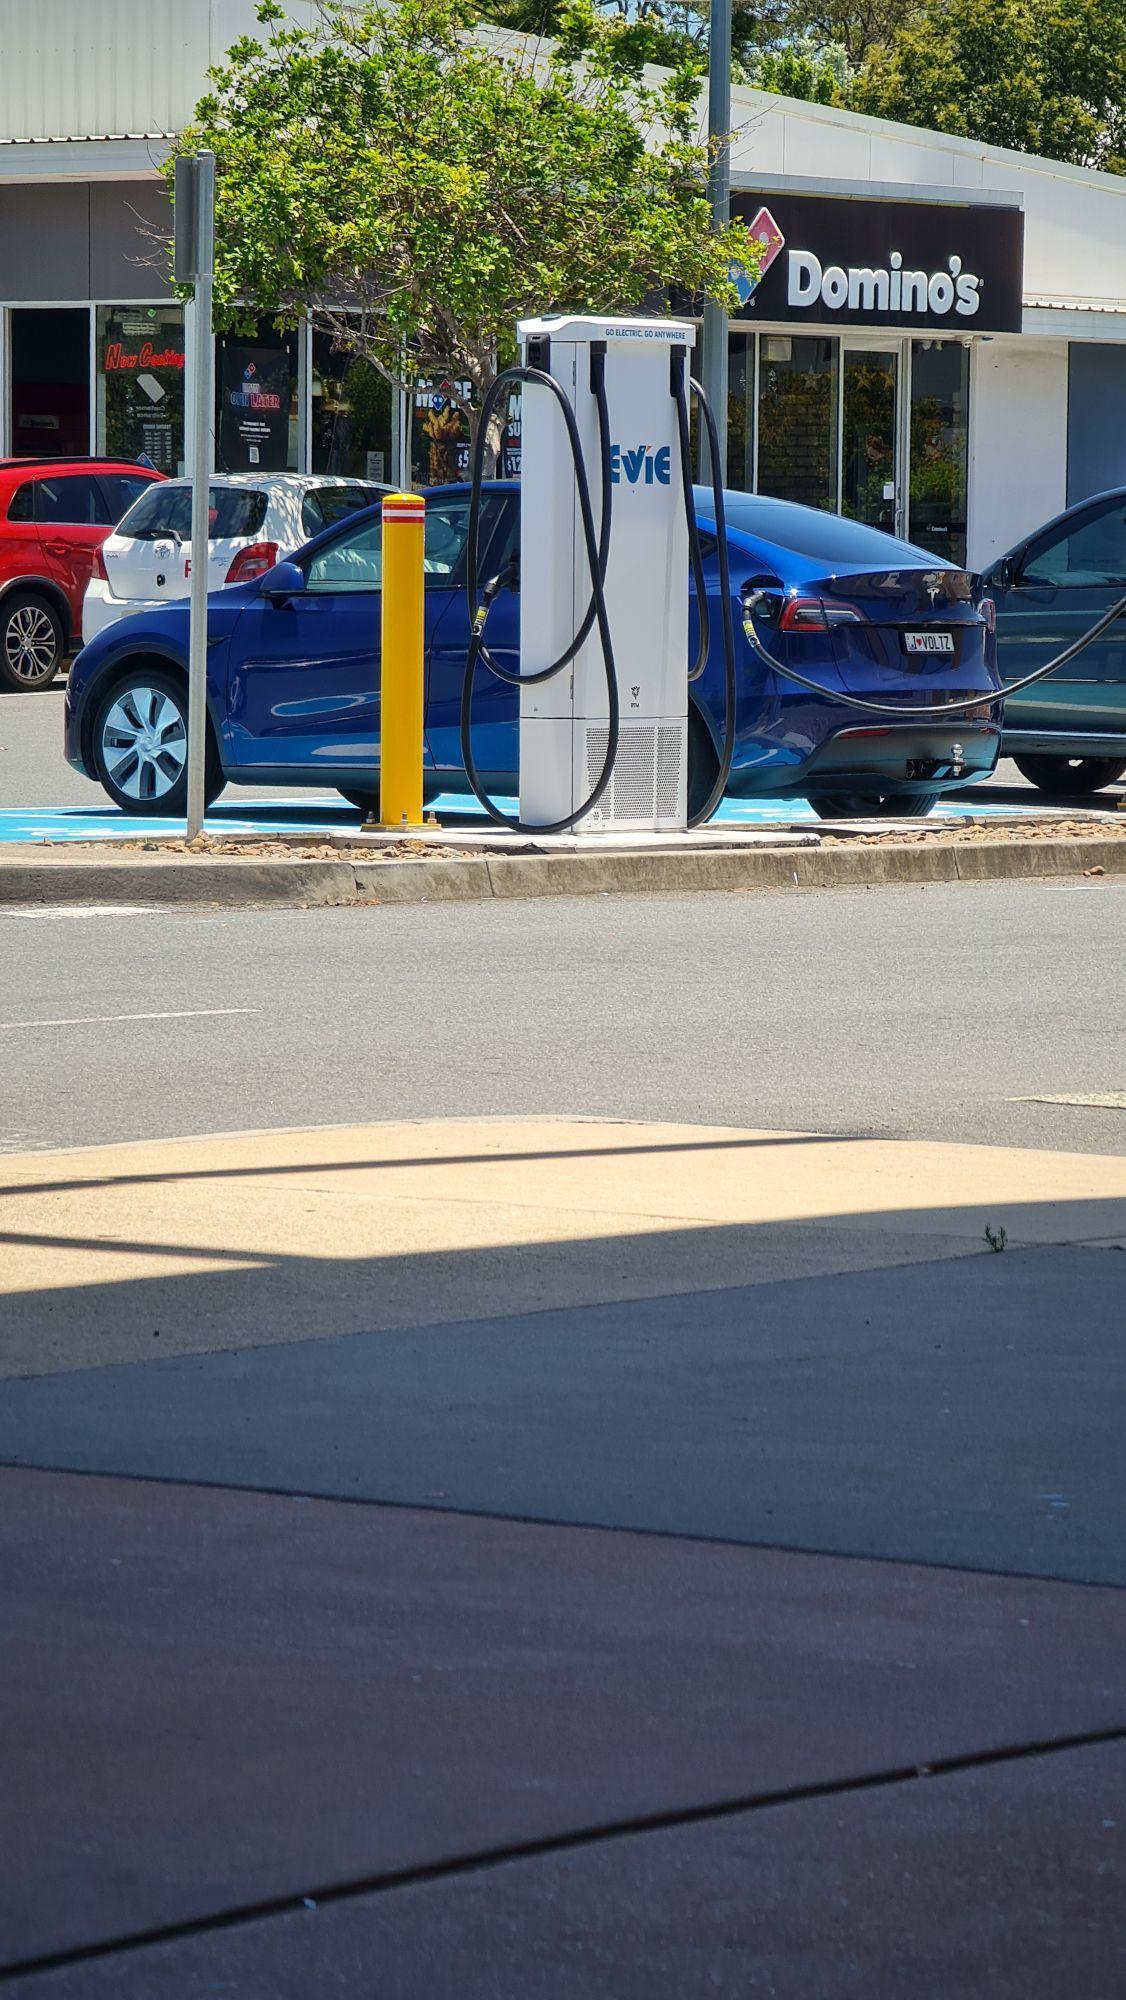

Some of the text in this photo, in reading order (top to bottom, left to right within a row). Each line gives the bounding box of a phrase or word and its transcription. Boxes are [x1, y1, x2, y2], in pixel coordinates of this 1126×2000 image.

[788, 250, 979, 316] Domino's
[606, 328, 614, 336] GO
[644, 330, 653, 338] GO
[654, 331, 685, 339] ANYWHERE
[250, 393, 281, 409] LATER
